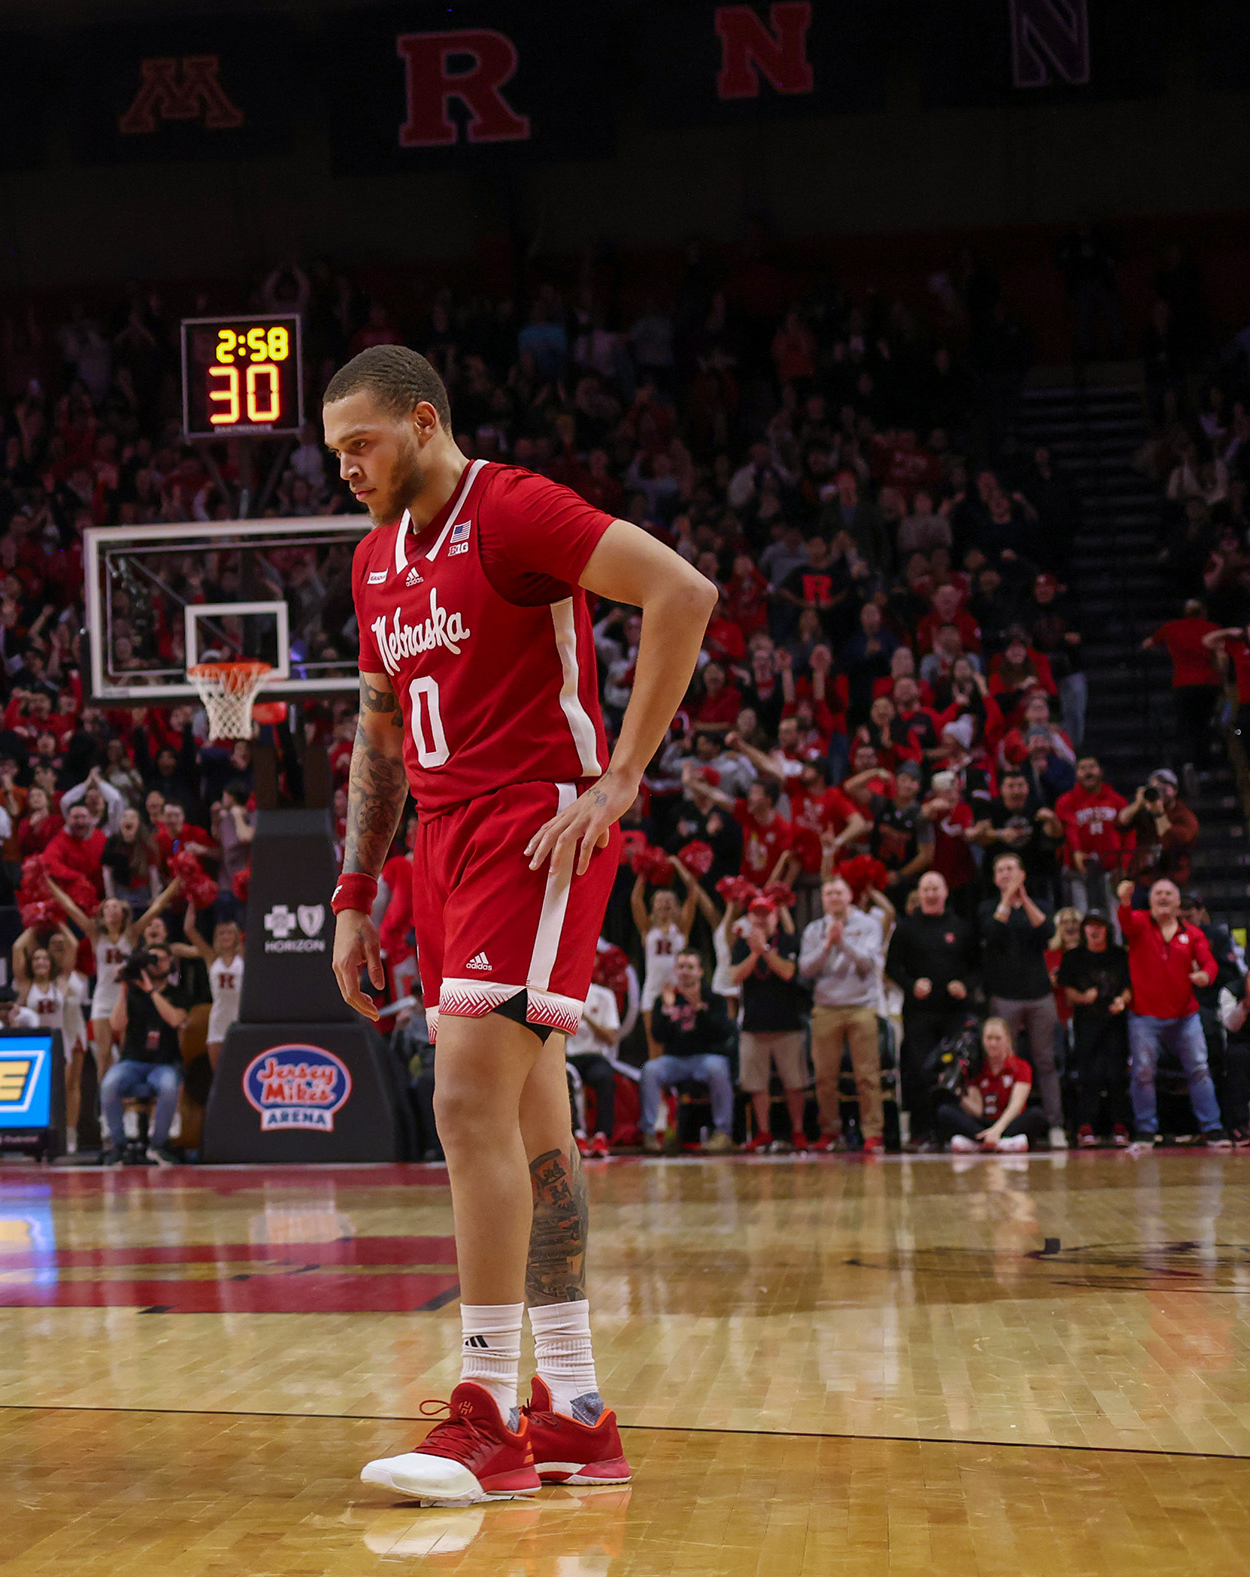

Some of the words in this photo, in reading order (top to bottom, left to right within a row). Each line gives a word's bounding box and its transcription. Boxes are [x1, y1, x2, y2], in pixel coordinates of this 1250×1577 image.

[715, 2, 814, 98] N
[396, 28, 531, 147] R
[215, 326, 290, 364] 2:58
[208, 363, 280, 424] 30
[405, 577, 425, 588] adidas
[370, 587, 471, 677] Nebraska
[409, 675, 450, 769] 0
[264, 939, 326, 952] HORIZON
[466, 963, 493, 971] adidas
[258, 1059, 336, 1086] Jersey
[268, 1111, 326, 1125] ARENA
